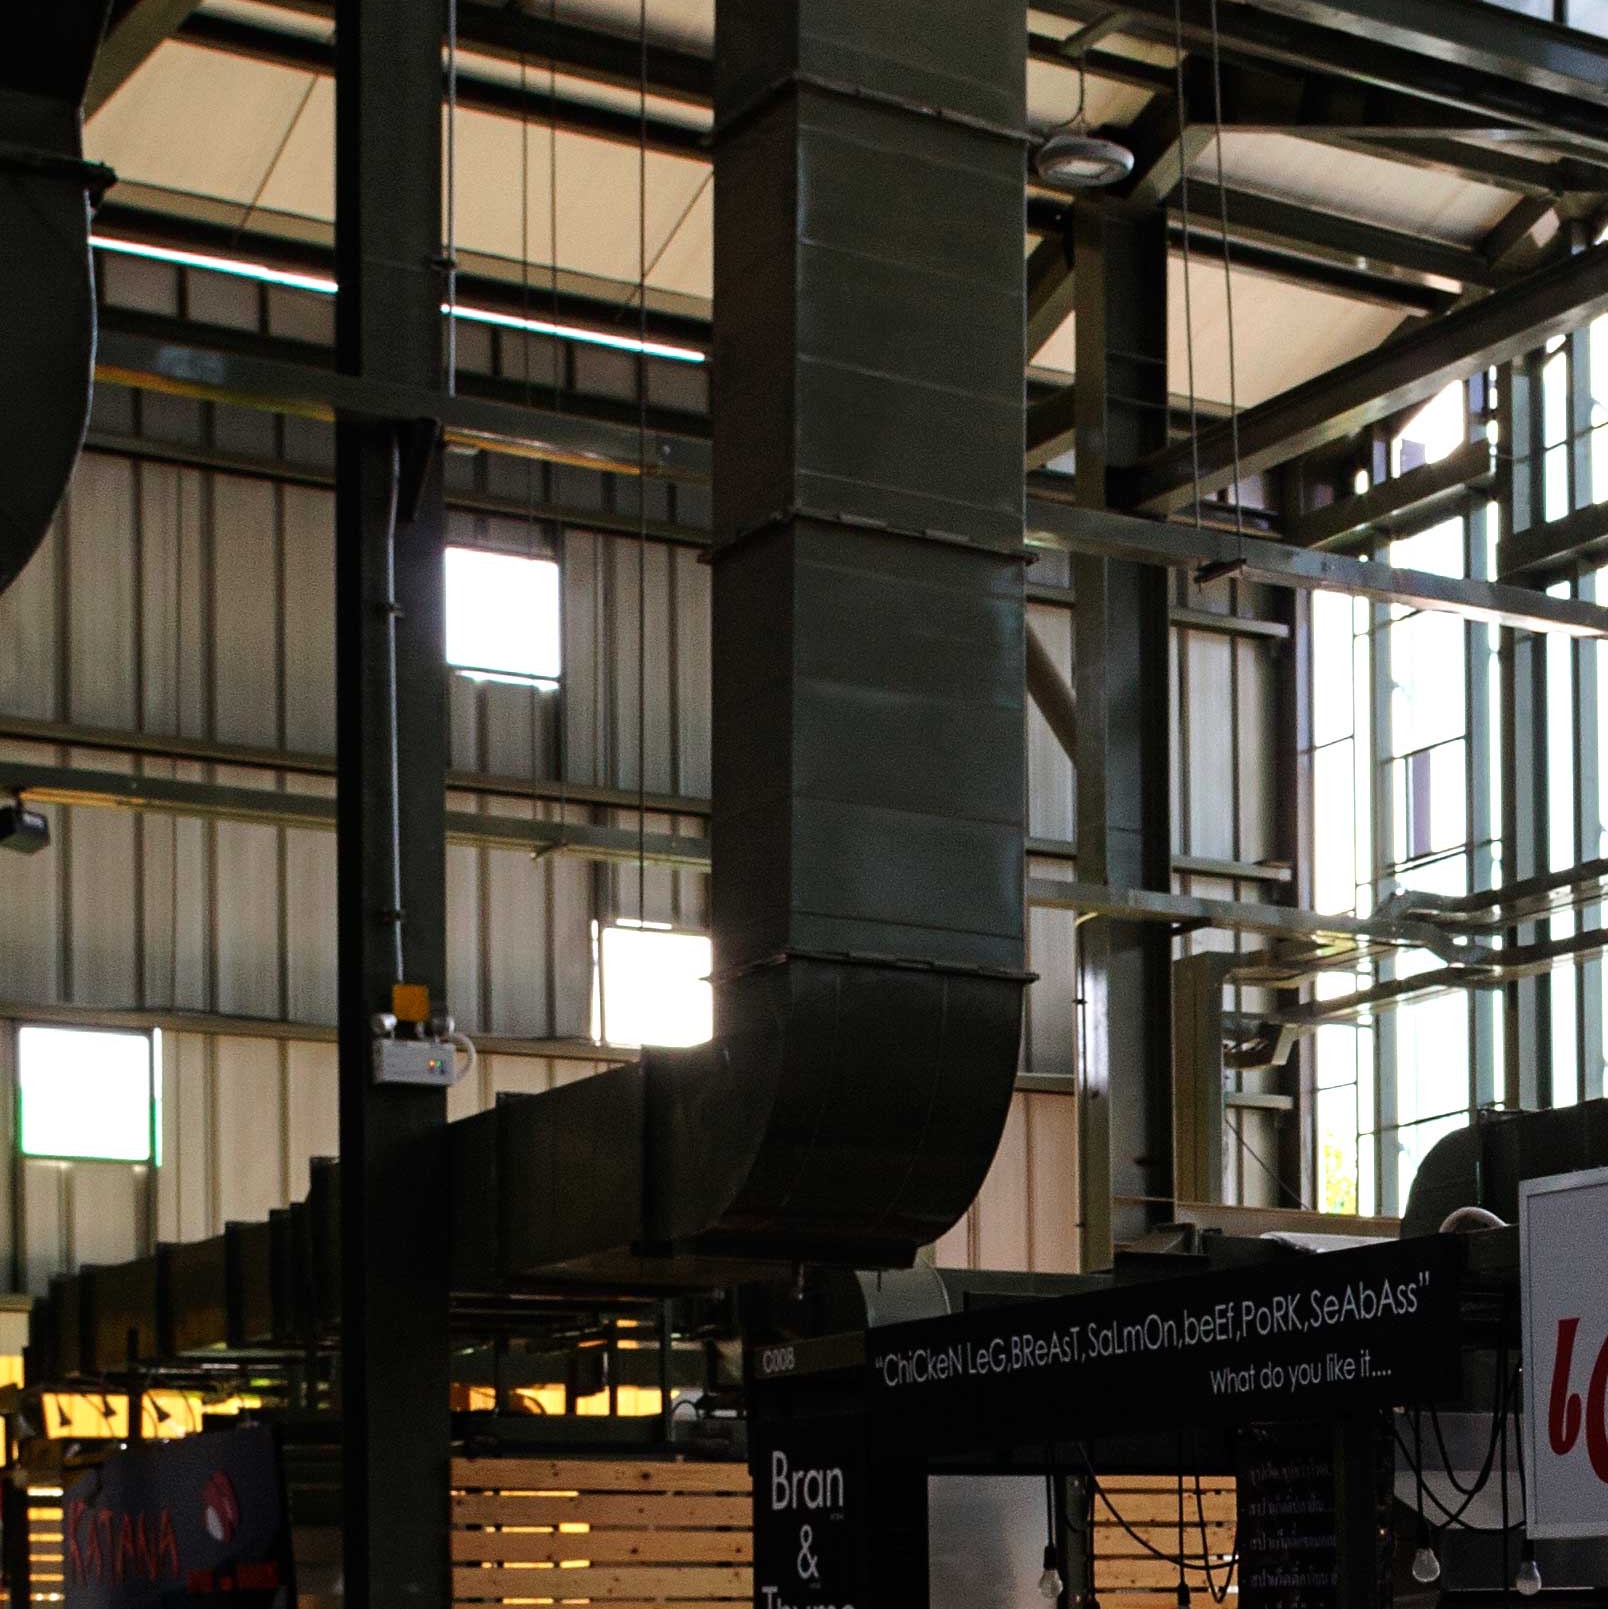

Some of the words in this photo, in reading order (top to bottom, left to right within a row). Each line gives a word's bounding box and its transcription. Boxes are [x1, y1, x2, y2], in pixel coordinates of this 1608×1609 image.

[1209, 1363, 1256, 1395] What
[1259, 1361, 1285, 1390] do
[1287, 1362, 1323, 1394] you
[1326, 1352, 1357, 1383] like
[771, 1449, 844, 1511] Bran
[797, 1523, 820, 1579] &
